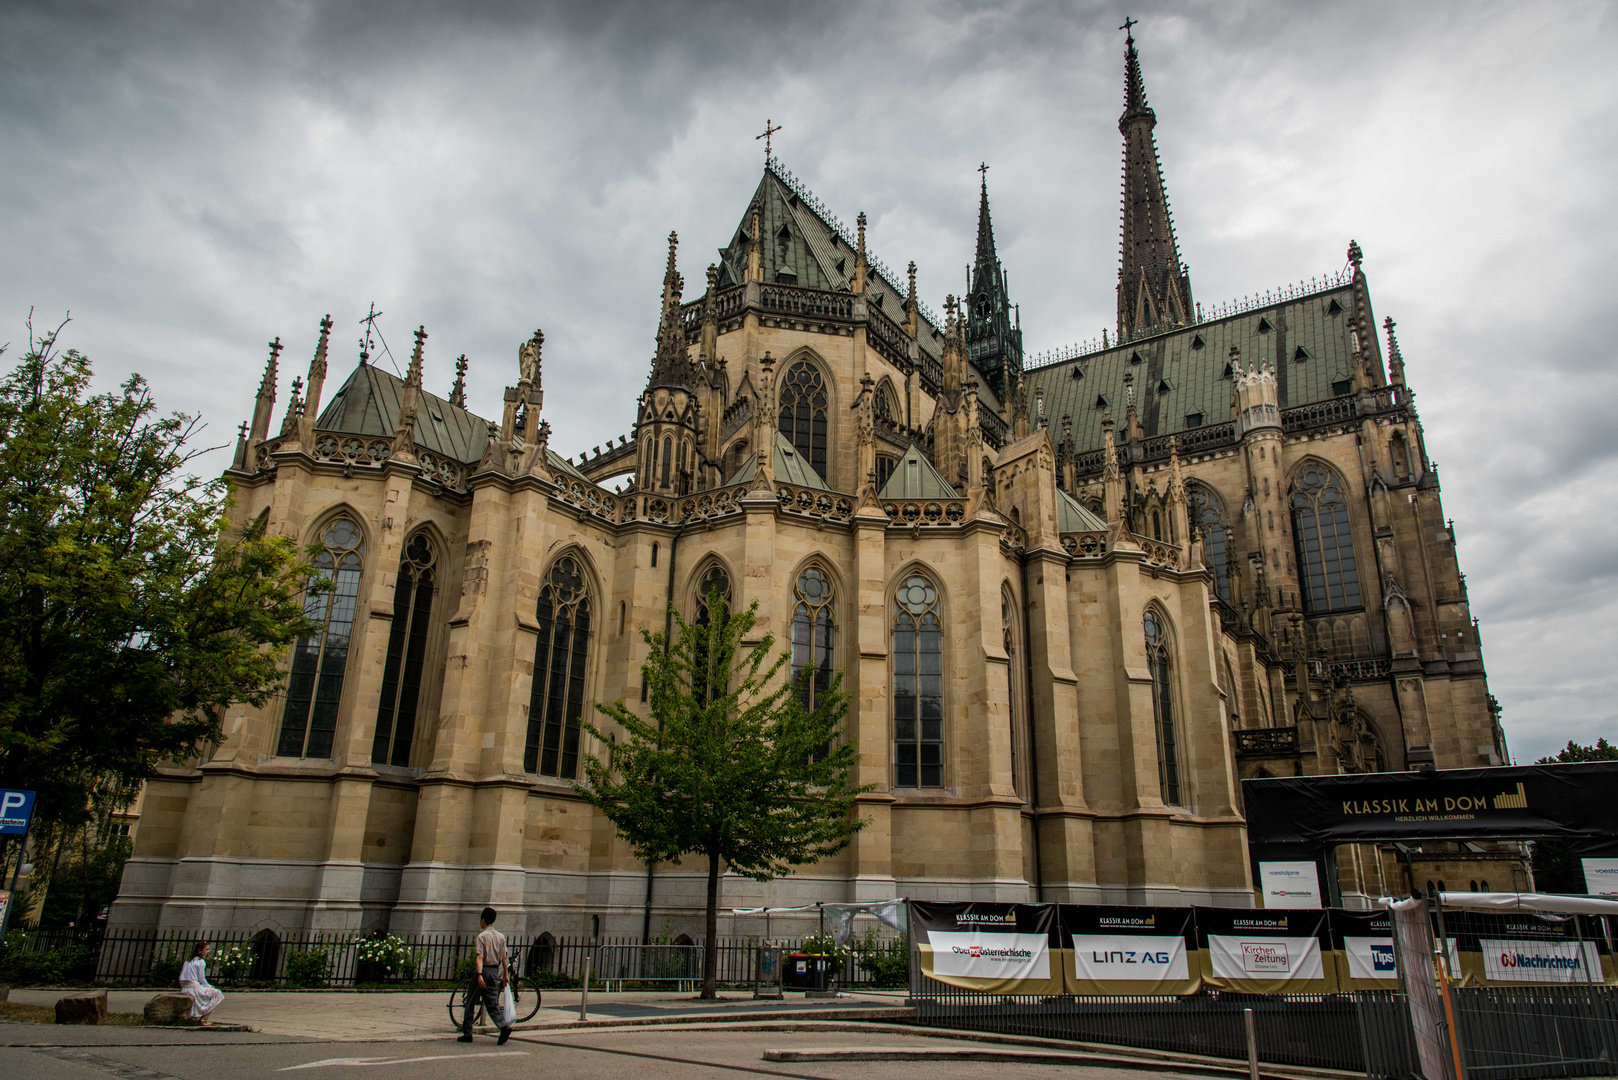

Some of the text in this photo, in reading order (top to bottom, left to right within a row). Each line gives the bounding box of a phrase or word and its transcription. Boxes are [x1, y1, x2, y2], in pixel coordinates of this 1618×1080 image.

[0, 792, 26, 818] P
[1342, 796, 1488, 815] KLASSIK AM DOM
[1394, 814, 1475, 823] HERZLICH WILLKOMMEN
[1243, 945, 1276, 955] Kirchen
[1092, 951, 1170, 964] LINZ AG
[1254, 954, 1287, 965] Zeitung
[1371, 950, 1394, 966] Tips
